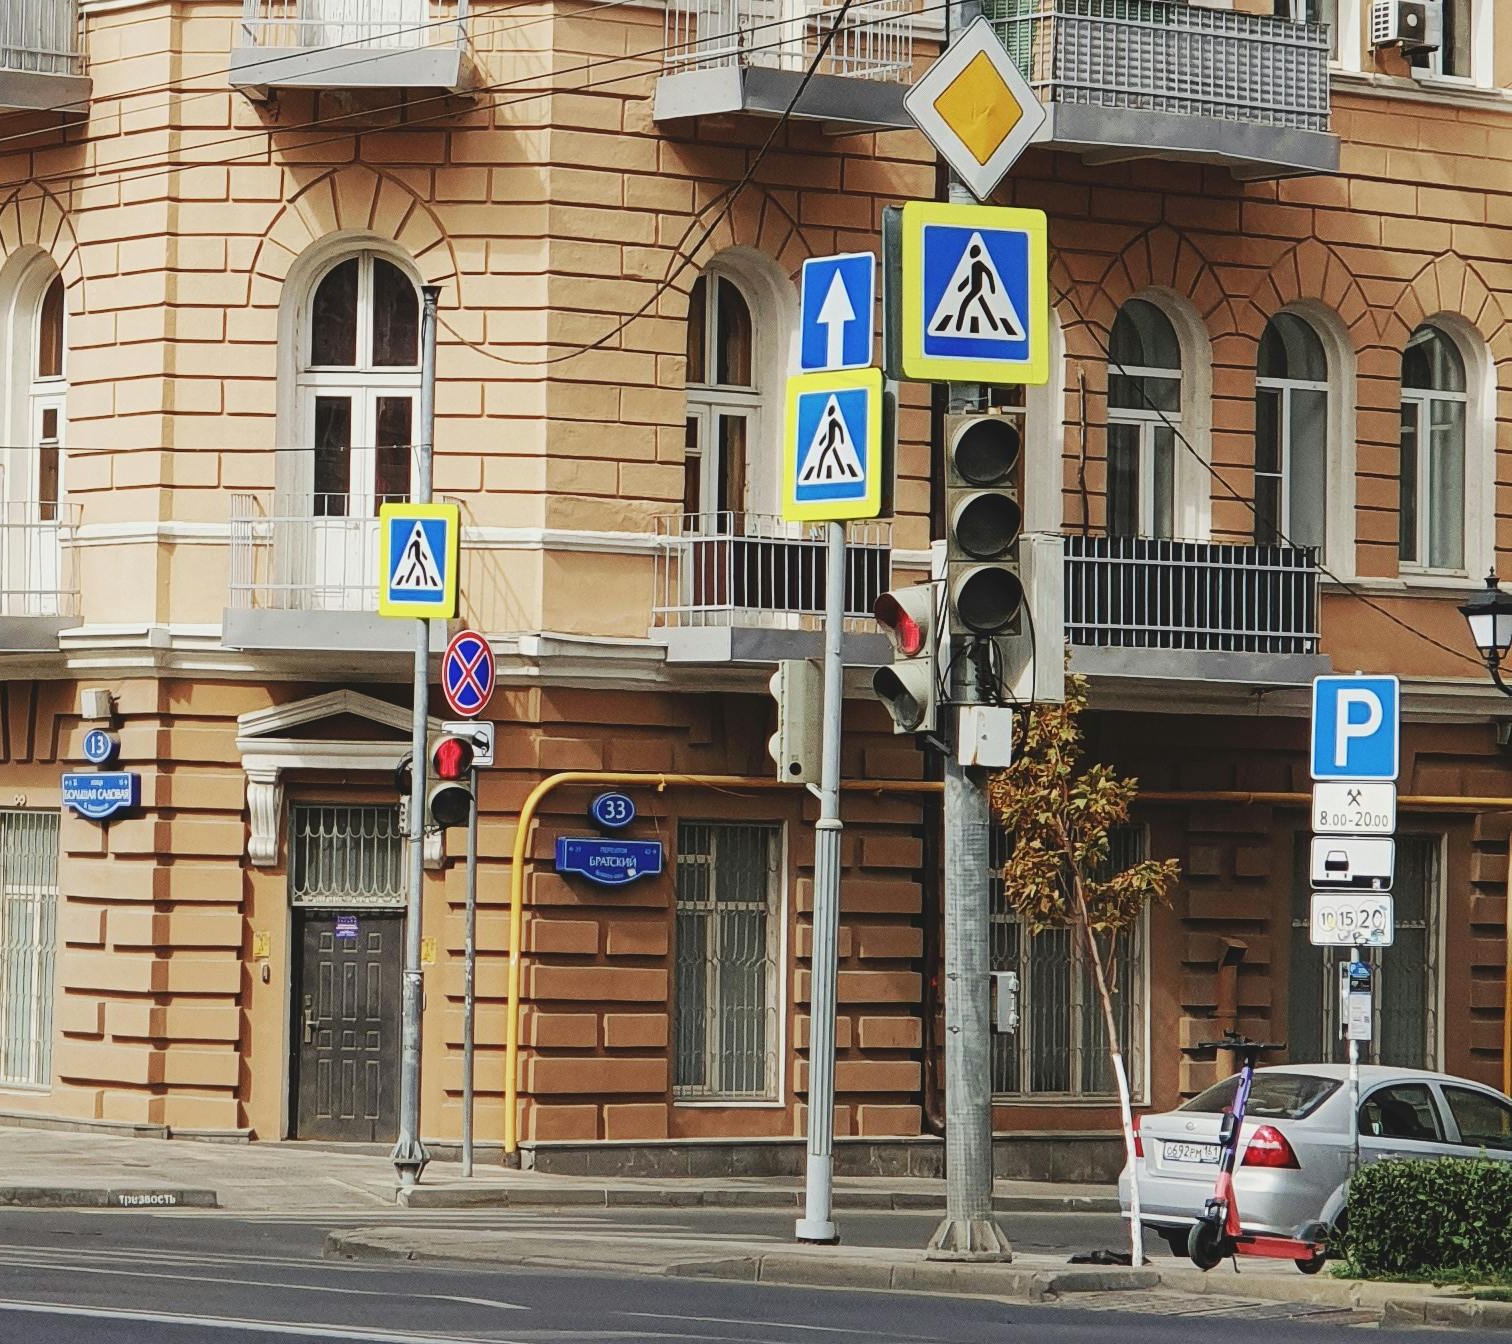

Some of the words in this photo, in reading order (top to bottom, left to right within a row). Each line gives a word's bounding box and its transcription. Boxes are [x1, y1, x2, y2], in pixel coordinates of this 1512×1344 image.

[1334, 688, 1384, 767] P
[91, 736, 104, 754] 13
[64, 789, 96, 800] БОЛЬШАЯ
[98, 788, 128, 800] САДОВАЯ
[605, 800, 626, 819] 33
[1320, 810, 1389, 827] 8.00-20.00
[589, 855, 637, 867] БРАТСКИЙ
[1340, 911, 1354, 926] 15
[1359, 909, 1383, 928] 20
